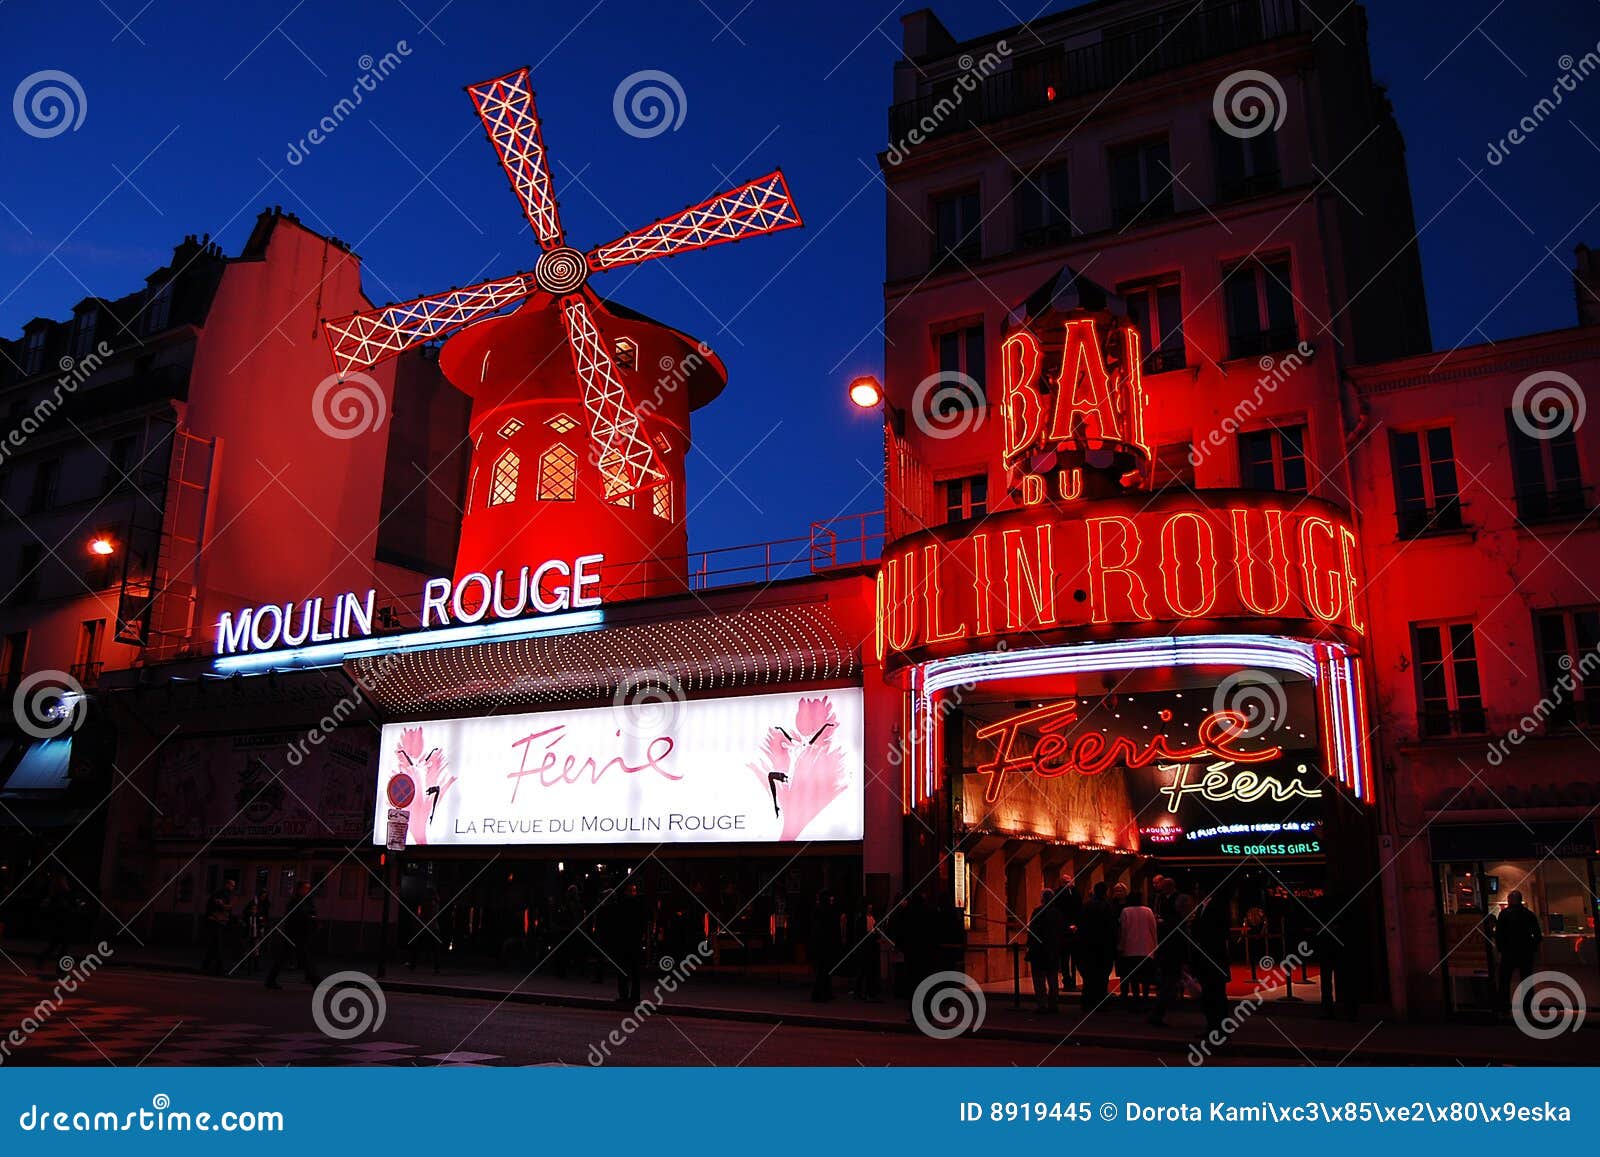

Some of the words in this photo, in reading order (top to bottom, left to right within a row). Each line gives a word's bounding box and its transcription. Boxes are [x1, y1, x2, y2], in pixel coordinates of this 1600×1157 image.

[1022, 469, 1084, 506] DU
[216, 588, 376, 654] MOULIN
[422, 553, 604, 627] ROUGE
[1085, 509, 1365, 637] ROUGE
[506, 724, 684, 804] Féerie
[976, 700, 1283, 804] Féerie
[550, 818, 575, 833] DU
[1221, 843, 1241, 855] LES
[1243, 844, 1286, 855] DORISS
[1287, 841, 1320, 854] GIRLS
